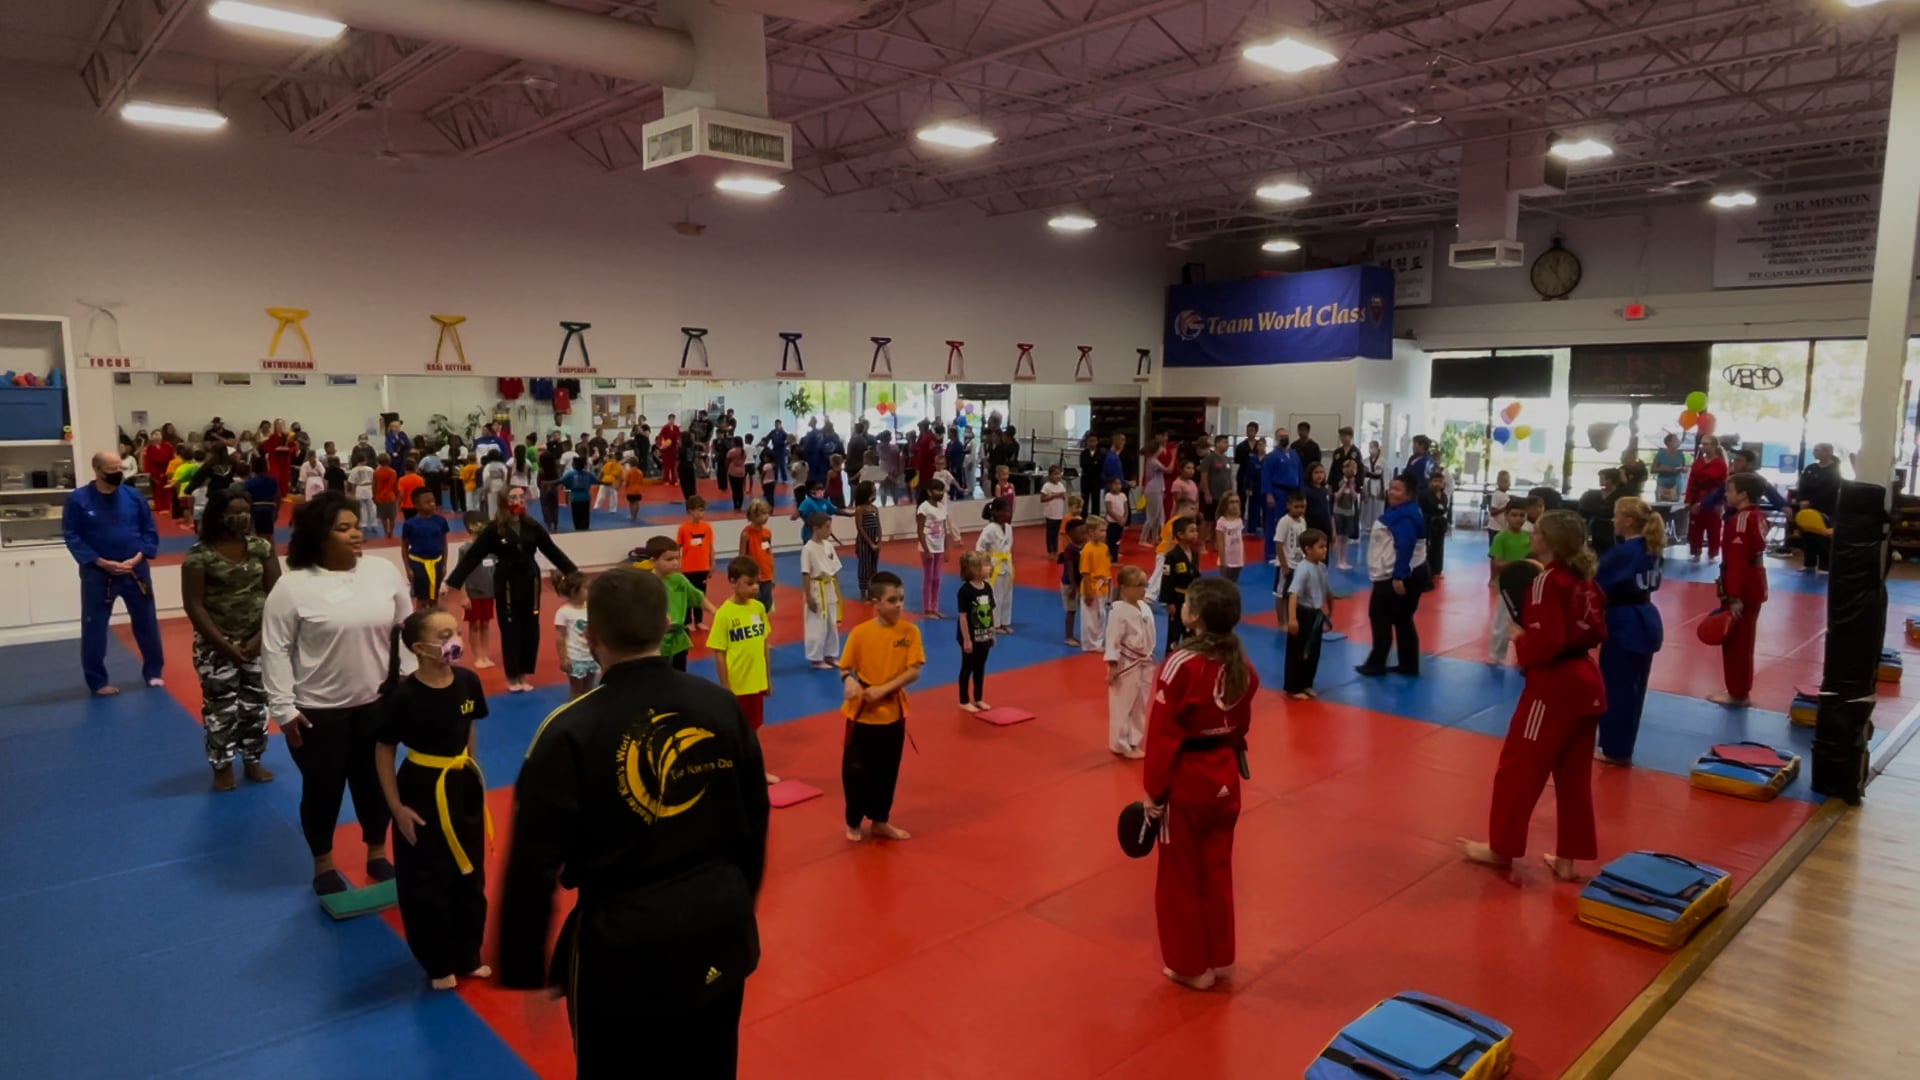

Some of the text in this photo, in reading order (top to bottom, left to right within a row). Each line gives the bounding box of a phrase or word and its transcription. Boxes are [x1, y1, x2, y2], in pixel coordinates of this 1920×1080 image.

[1773, 193, 1871, 213] OUR MISSION
[1207, 303, 1366, 335] Team World Class
[90, 357, 131, 369] FOCUS
[717, 757, 734, 769] Do
